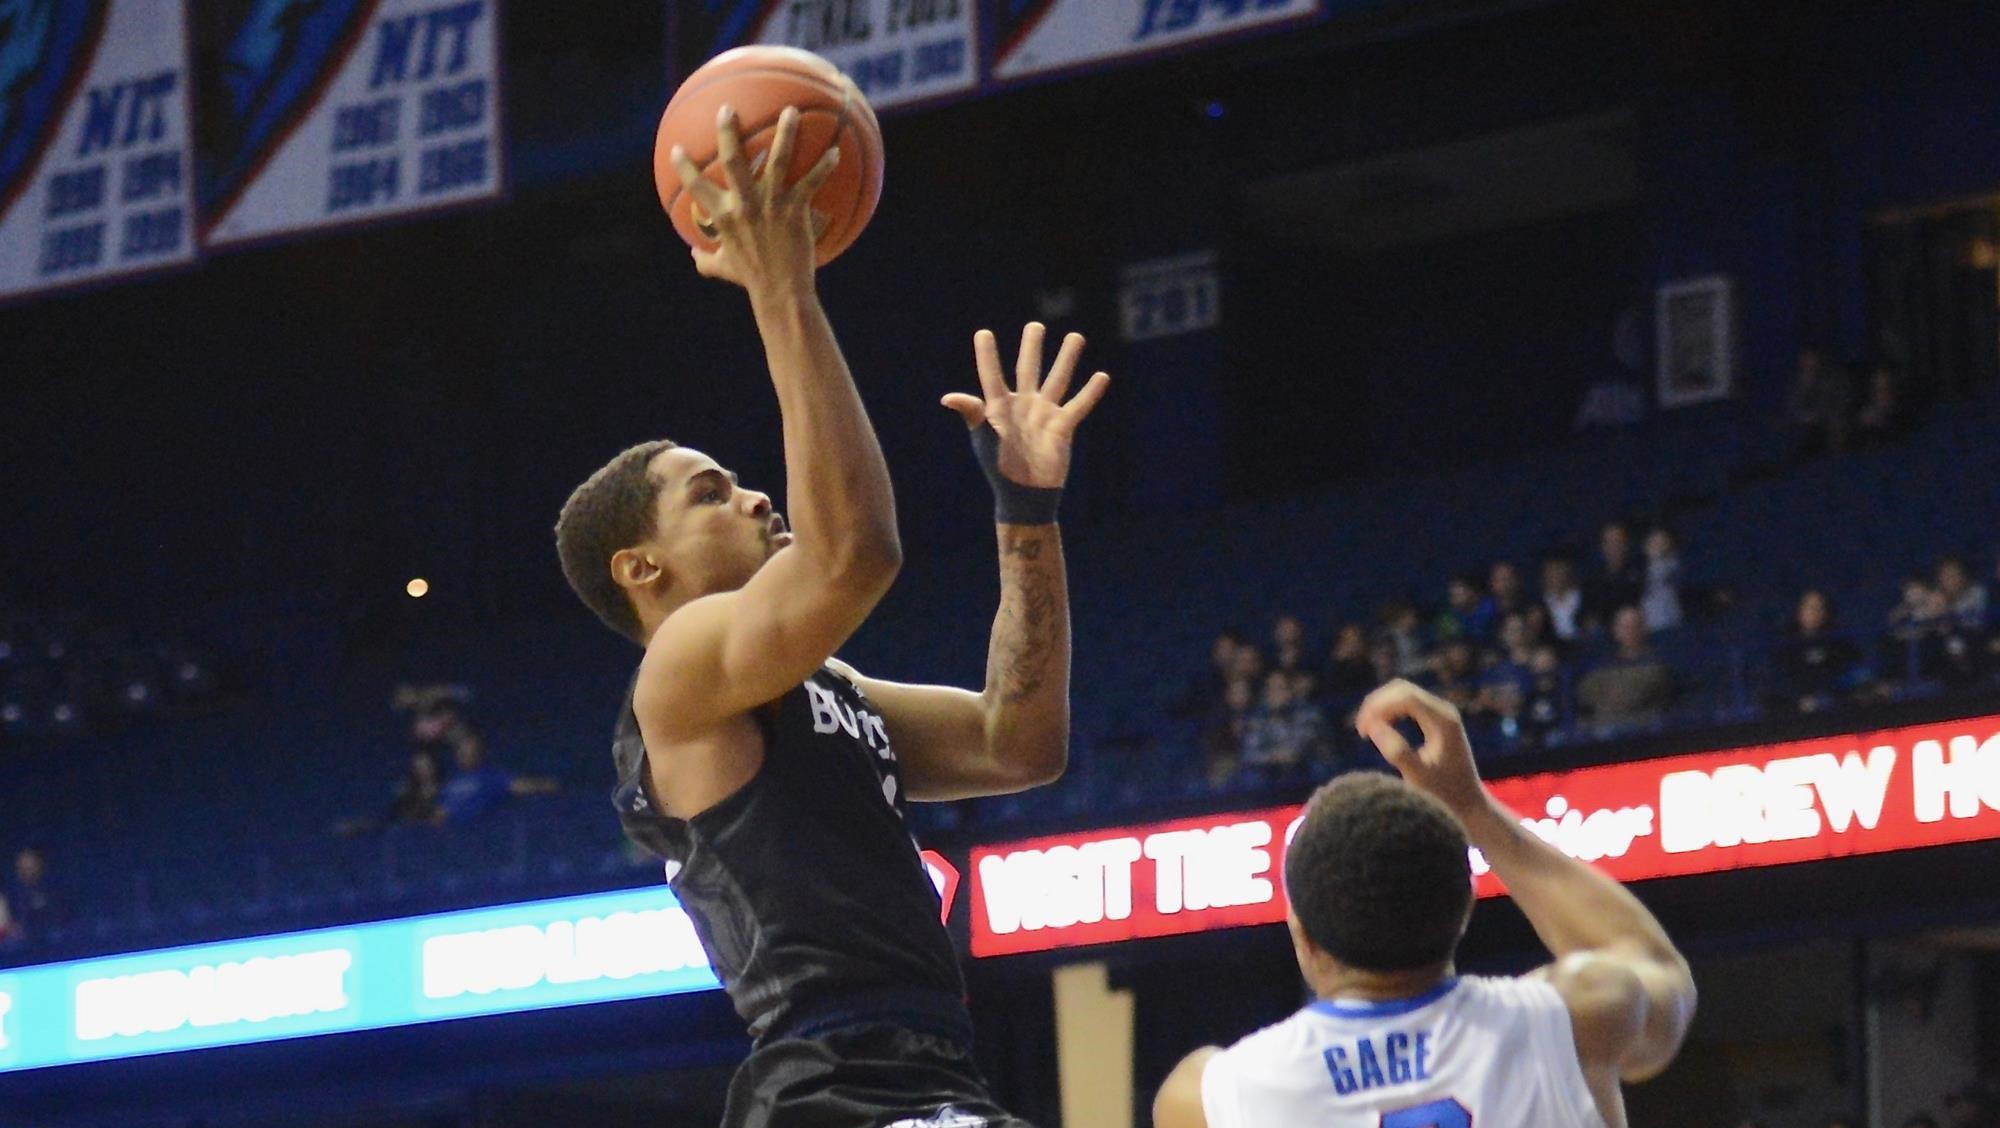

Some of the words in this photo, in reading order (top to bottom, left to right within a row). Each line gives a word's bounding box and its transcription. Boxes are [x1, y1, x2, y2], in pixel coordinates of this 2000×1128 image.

[370, 2, 486, 88] NIT
[78, 72, 177, 157] NIT
[1323, 1031, 1433, 1096] GAGE
